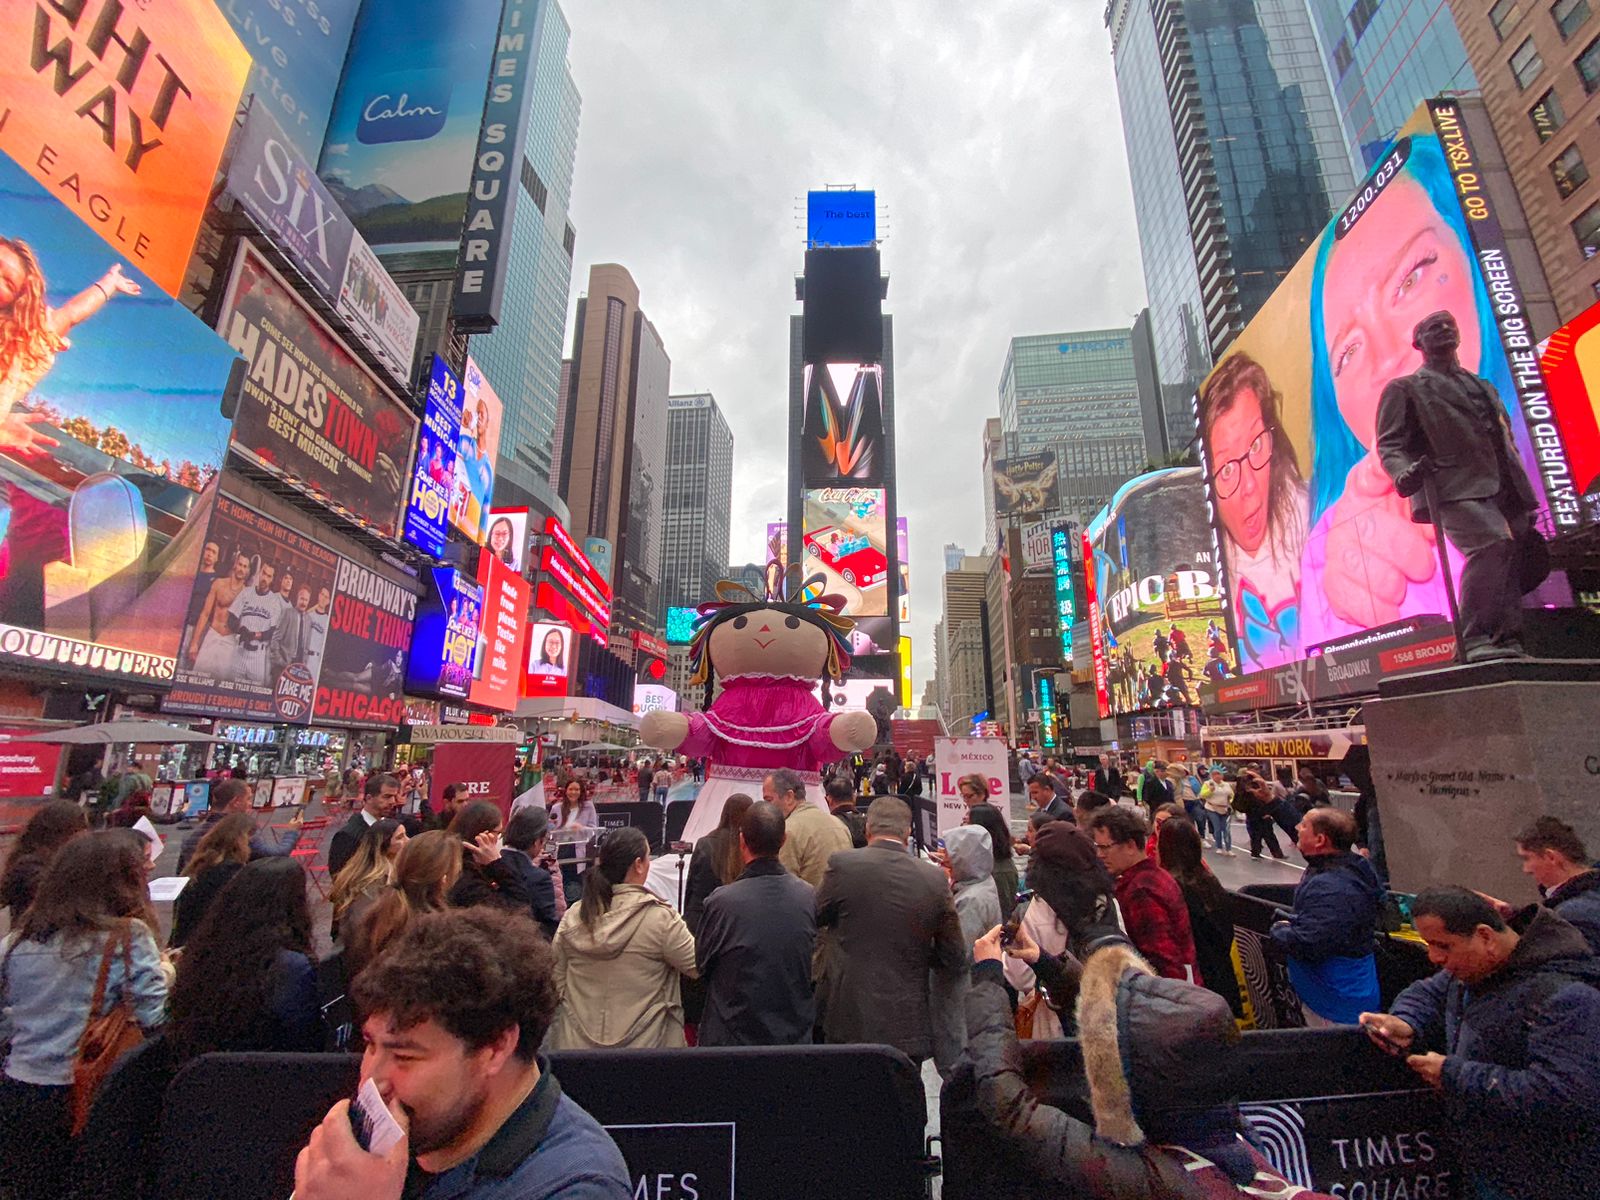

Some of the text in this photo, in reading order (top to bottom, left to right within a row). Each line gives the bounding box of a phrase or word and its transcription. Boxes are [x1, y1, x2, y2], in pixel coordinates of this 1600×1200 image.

[30, 3, 163, 174] WAY
[364, 93, 443, 122] Calm
[462, 0, 524, 294] IMES SQUARE
[1437, 105, 1489, 221] GO TO TSX.LIVE
[36, 143, 150, 259] EAGLE
[254, 139, 337, 271] SIX
[1340, 151, 1403, 231] 1200.031
[823, 210, 870, 219] The best
[260, 316, 282, 343] COME
[281, 336, 295, 353] SEE
[443, 371, 457, 400] 13
[1480, 248, 1577, 525] FEATURED ON THE BIG SCREEN
[244, 379, 278, 412] DWAY'S
[279, 405, 300, 426] TONY
[300, 422, 315, 441] AND
[435, 411, 452, 434] BEST
[267, 412, 339, 475] BEST MUSICAL
[425, 413, 456, 453] MUSICAL
[411, 477, 448, 525] HOT
[217, 497, 230, 512] HE
[275, 525, 288, 540] HIT
[288, 533, 297, 544] OF
[1027, 521, 1055, 537] LITTLE
[1196, 552, 1211, 563] AN
[338, 559, 417, 621] BROADWAY'S
[1112, 574, 1165, 623] EPIC
[331, 595, 413, 652] SURE THING
[1, 629, 174, 679] OUTFITTERS
[442, 630, 475, 668] HOT
[1393, 651, 1414, 664] 1568
[1327, 659, 1371, 682] BROADWAY
[278, 676, 313, 703] TAKE ME
[281, 700, 300, 716] OUT
[314, 687, 404, 724] CHICAGO
[445, 706, 459, 717] BLUE
[413, 728, 484, 740] SWAROVSKI
[1256, 740, 1279, 756] NEW
[1282, 739, 1313, 756] YORK
[0, 754, 35, 764] oadway
[961, 753, 994, 761] MÉXICO
[941, 772, 1003, 795] Le
[943, 802, 962, 810] NEW
[1331, 1131, 1435, 1169] TIMES
[633, 1173, 698, 1200] MES
